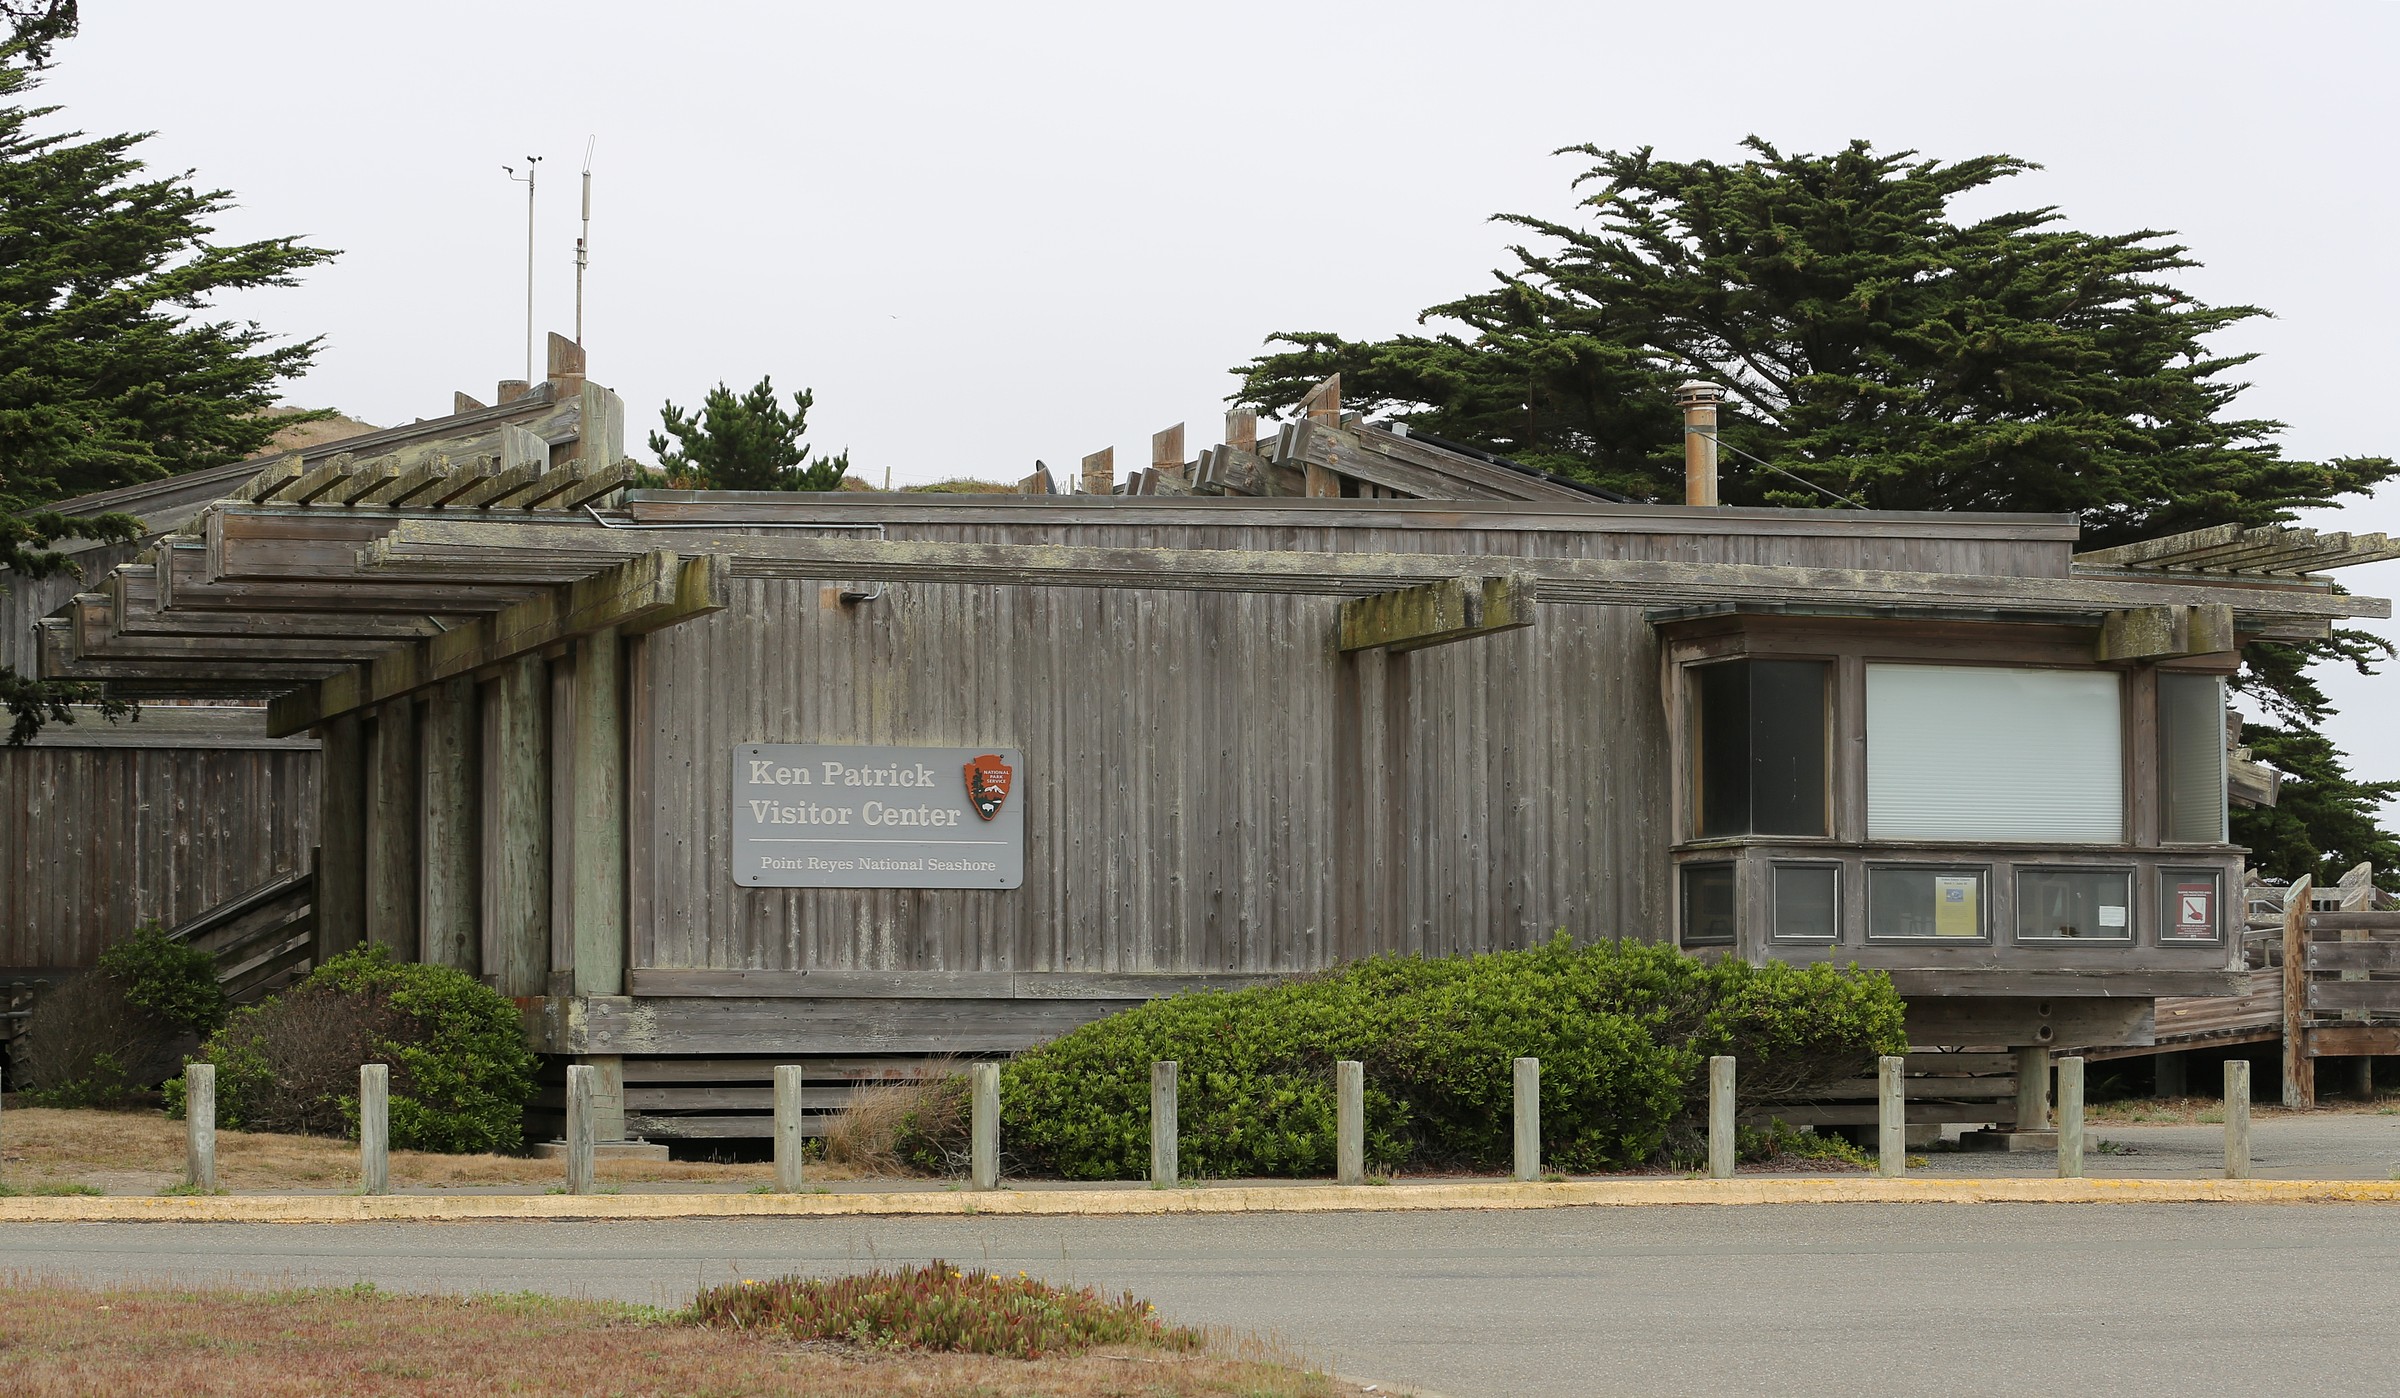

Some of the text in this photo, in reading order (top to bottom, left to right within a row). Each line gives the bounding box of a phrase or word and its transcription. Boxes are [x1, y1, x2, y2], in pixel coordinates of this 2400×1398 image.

[749, 760, 935, 788] Ken Patrick
[749, 799, 961, 827] Visitor Center
[761, 856, 996, 873] Point Reyes National Seashore
